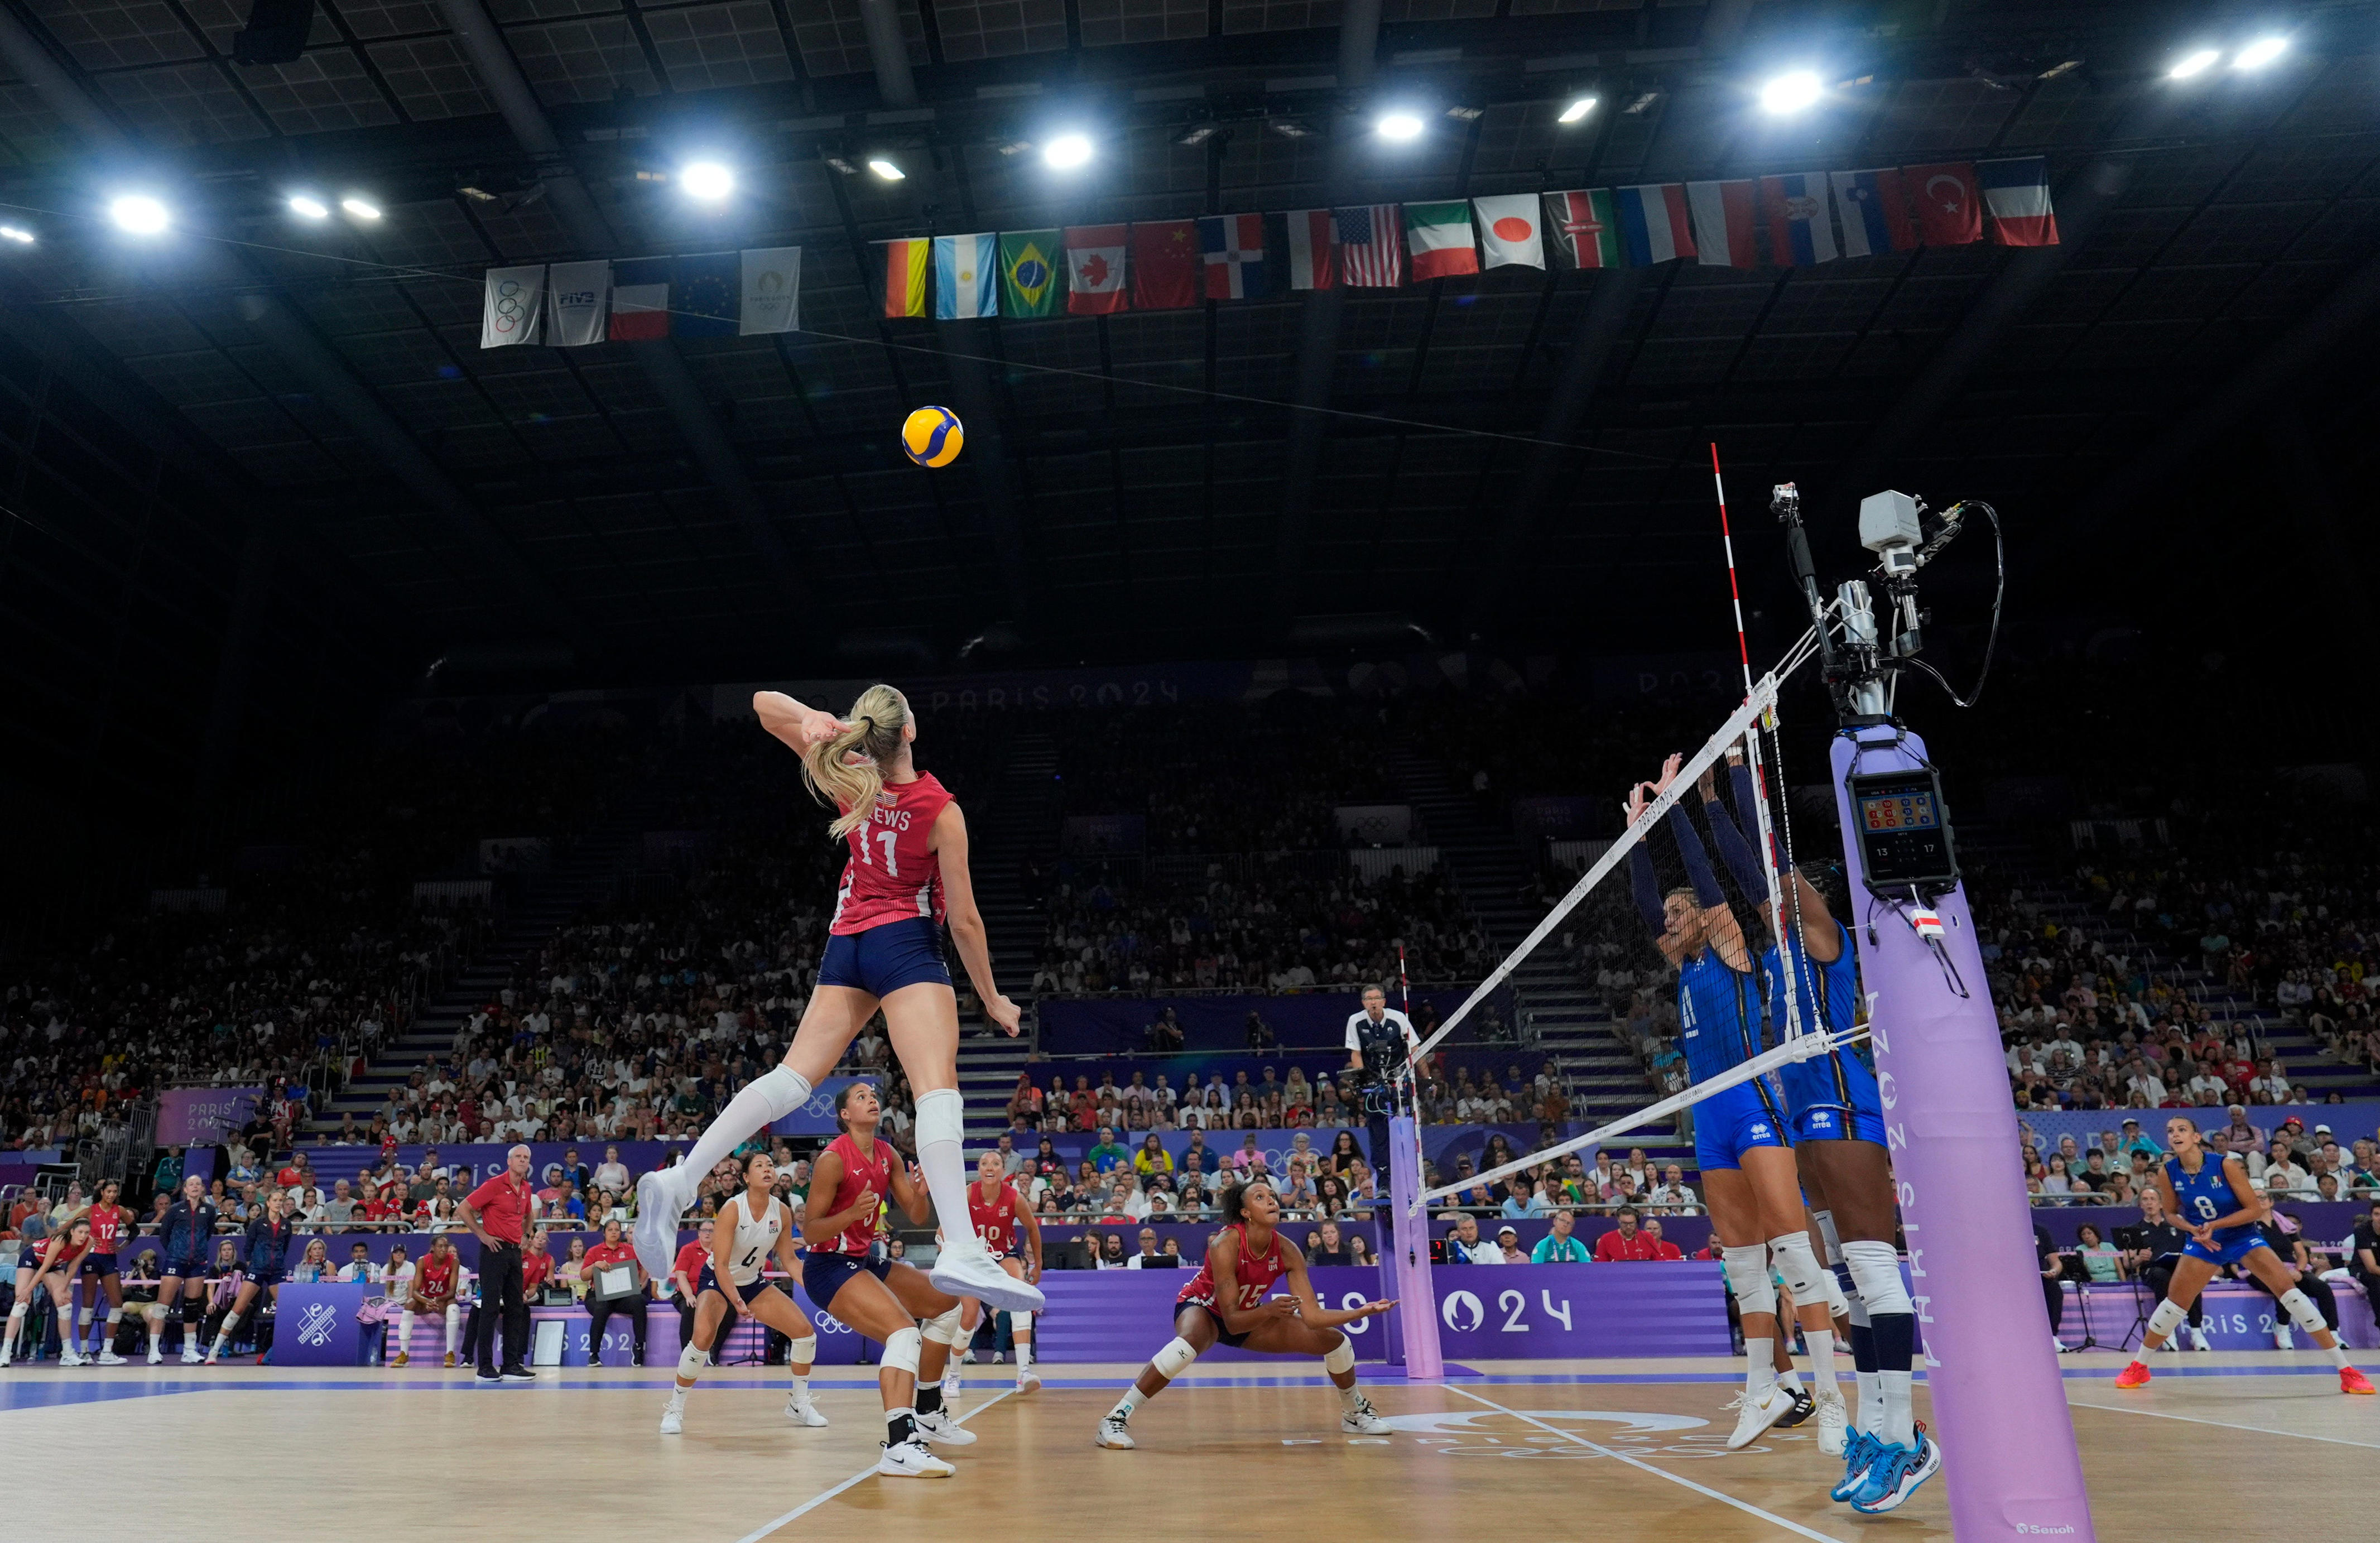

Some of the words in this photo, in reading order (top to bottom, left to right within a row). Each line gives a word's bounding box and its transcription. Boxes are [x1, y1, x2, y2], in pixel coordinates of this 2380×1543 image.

[869, 807, 911, 831] EWS
[1638, 805, 1656, 832] PARIS
[1655, 788, 1673, 814] 2024
[860, 820, 899, 878] 11
[1924, 844, 1934, 853] 17
[1865, 991, 1907, 1151] 2024
[189, 1103, 232, 1116] PARIS
[1752, 1132, 1771, 1140] errea
[2194, 1196, 2218, 1220] 8
[100, 1224, 114, 1239] 12
[977, 1224, 1001, 1241] 10
[741, 1247, 758, 1268] 4
[1268, 1263, 1278, 1271] USA
[1898, 1181, 1941, 1367] PARIS
[428, 1281, 444, 1294] 24
[1239, 1284, 1268, 1309] 15
[1443, 1290, 1573, 1332] 024
[1281, 1437, 1569, 1445] PARIS
[2030, 1524, 2075, 1534] Senoh
